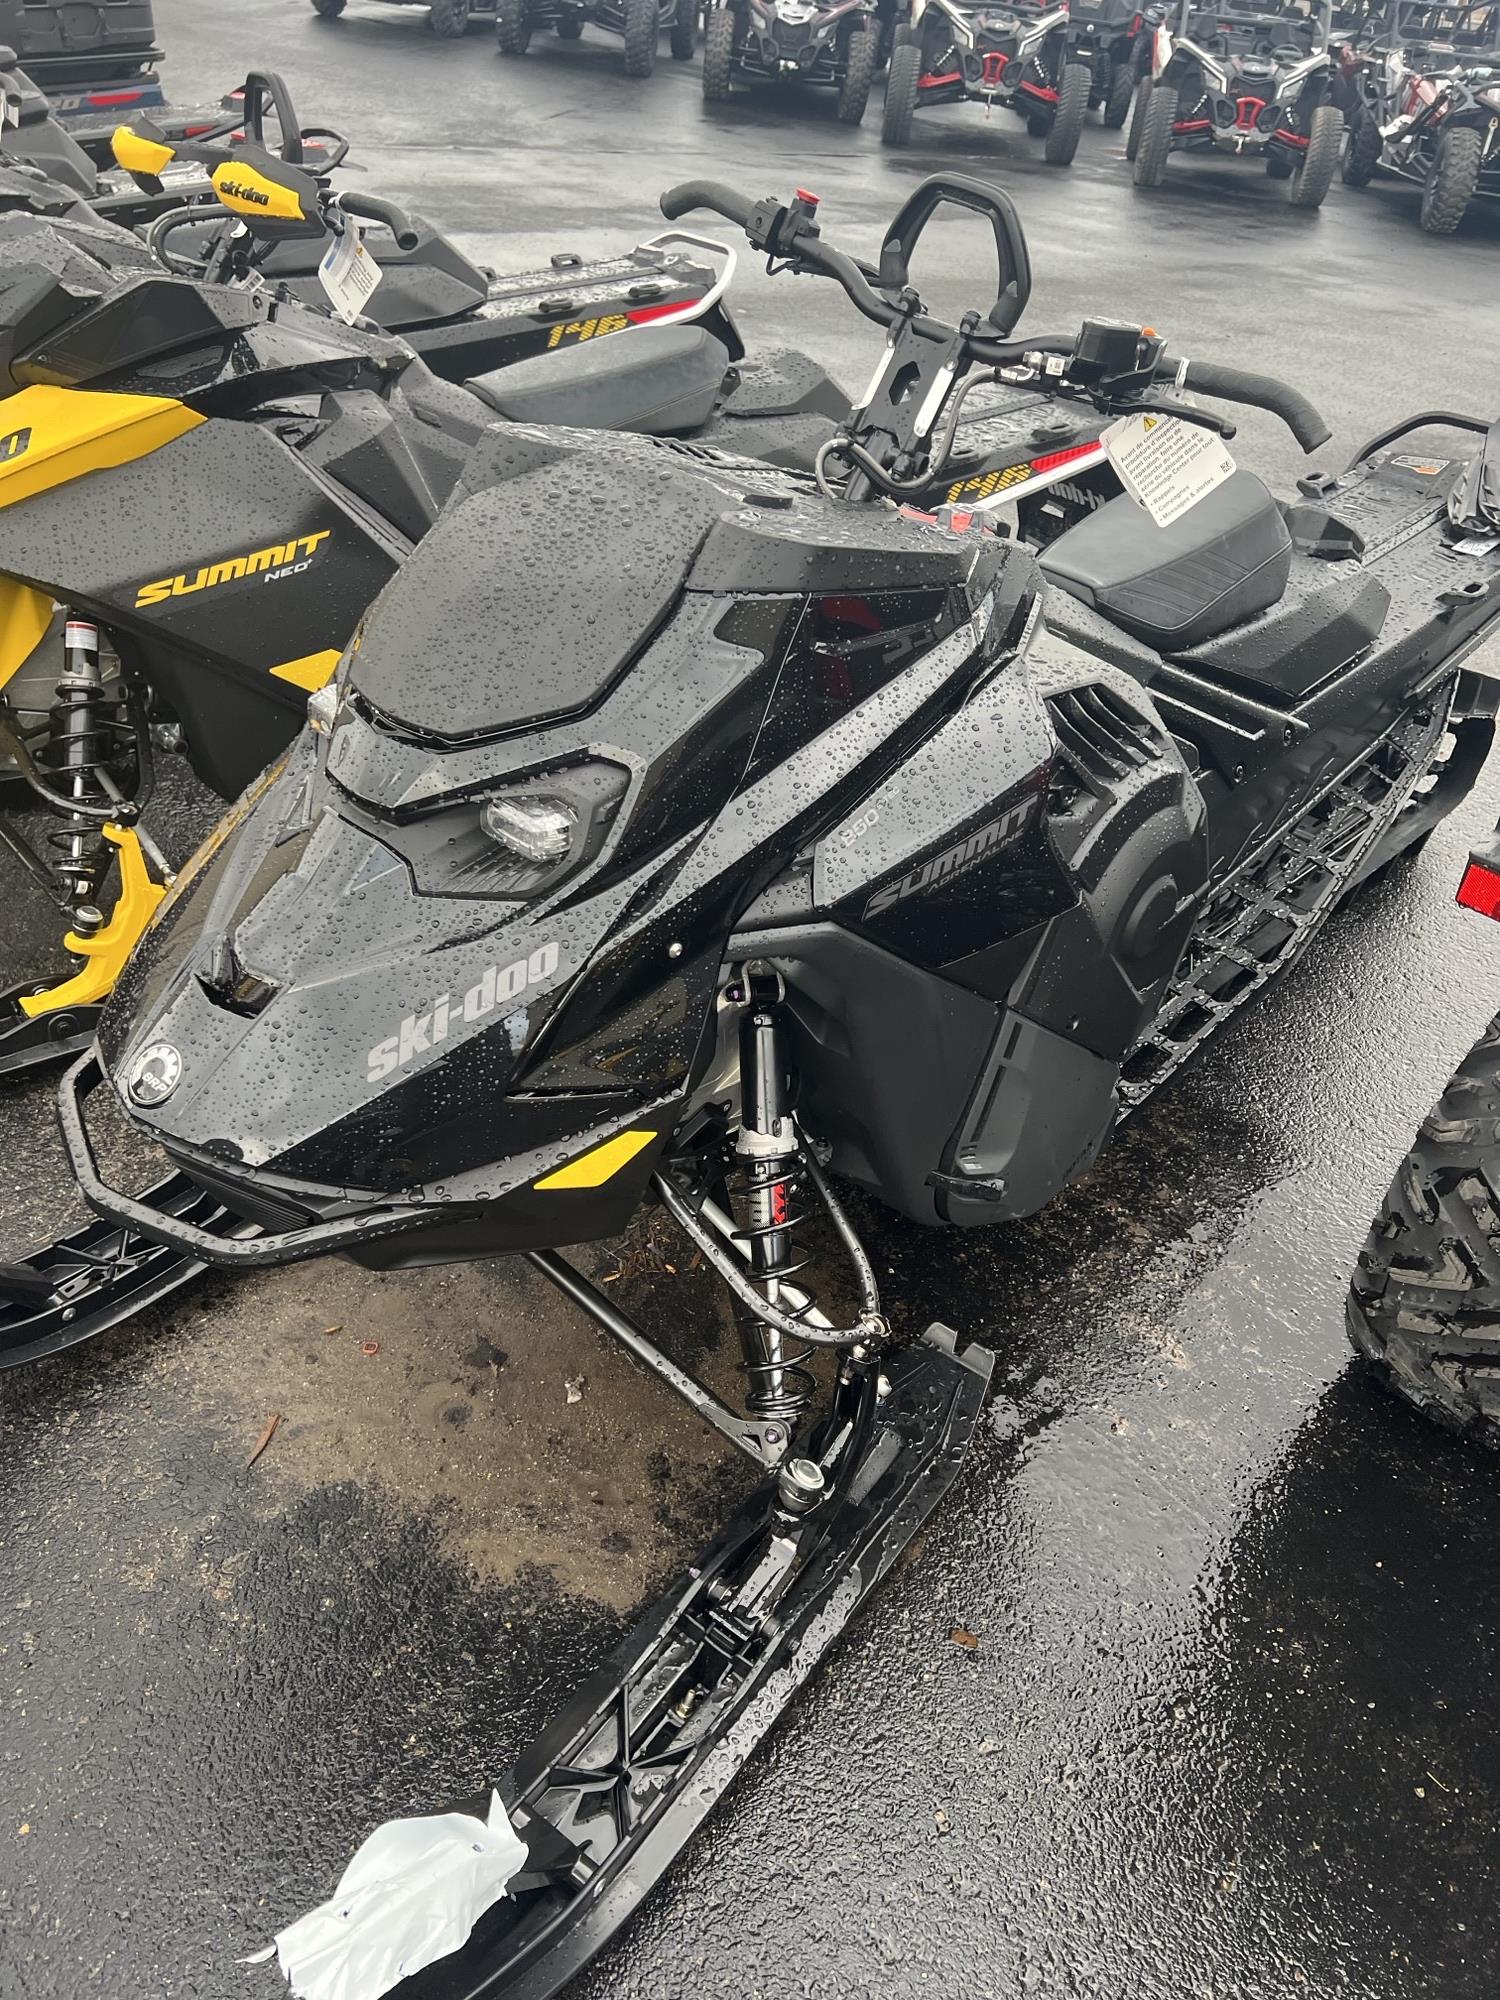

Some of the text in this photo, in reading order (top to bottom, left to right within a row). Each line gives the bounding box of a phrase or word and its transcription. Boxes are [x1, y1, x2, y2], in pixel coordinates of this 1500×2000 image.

[220, 180, 269, 206] ski-doo
[548, 314, 628, 348] 146
[1120, 449, 1135, 462] Avant
[1130, 461, 1143, 474] avant
[1143, 442, 1166, 461] livraison
[1161, 445, 1172, 456] faire
[1174, 436, 1183, 446] une
[1172, 459, 1189, 474] Center
[1190, 448, 1202, 460] pour
[1202, 437, 1214, 449] tout
[1184, 443, 1197, 455] dans
[947, 463, 1031, 504] 146
[1137, 463, 1162, 486] recherche
[134, 530, 331, 608] SUMMIT
[862, 793, 1038, 922] SUMMIT
[927, 829, 1024, 895] ADRENALINE
[367, 942, 560, 1083] ski-doo
[142, 1072, 169, 1092] BRP
